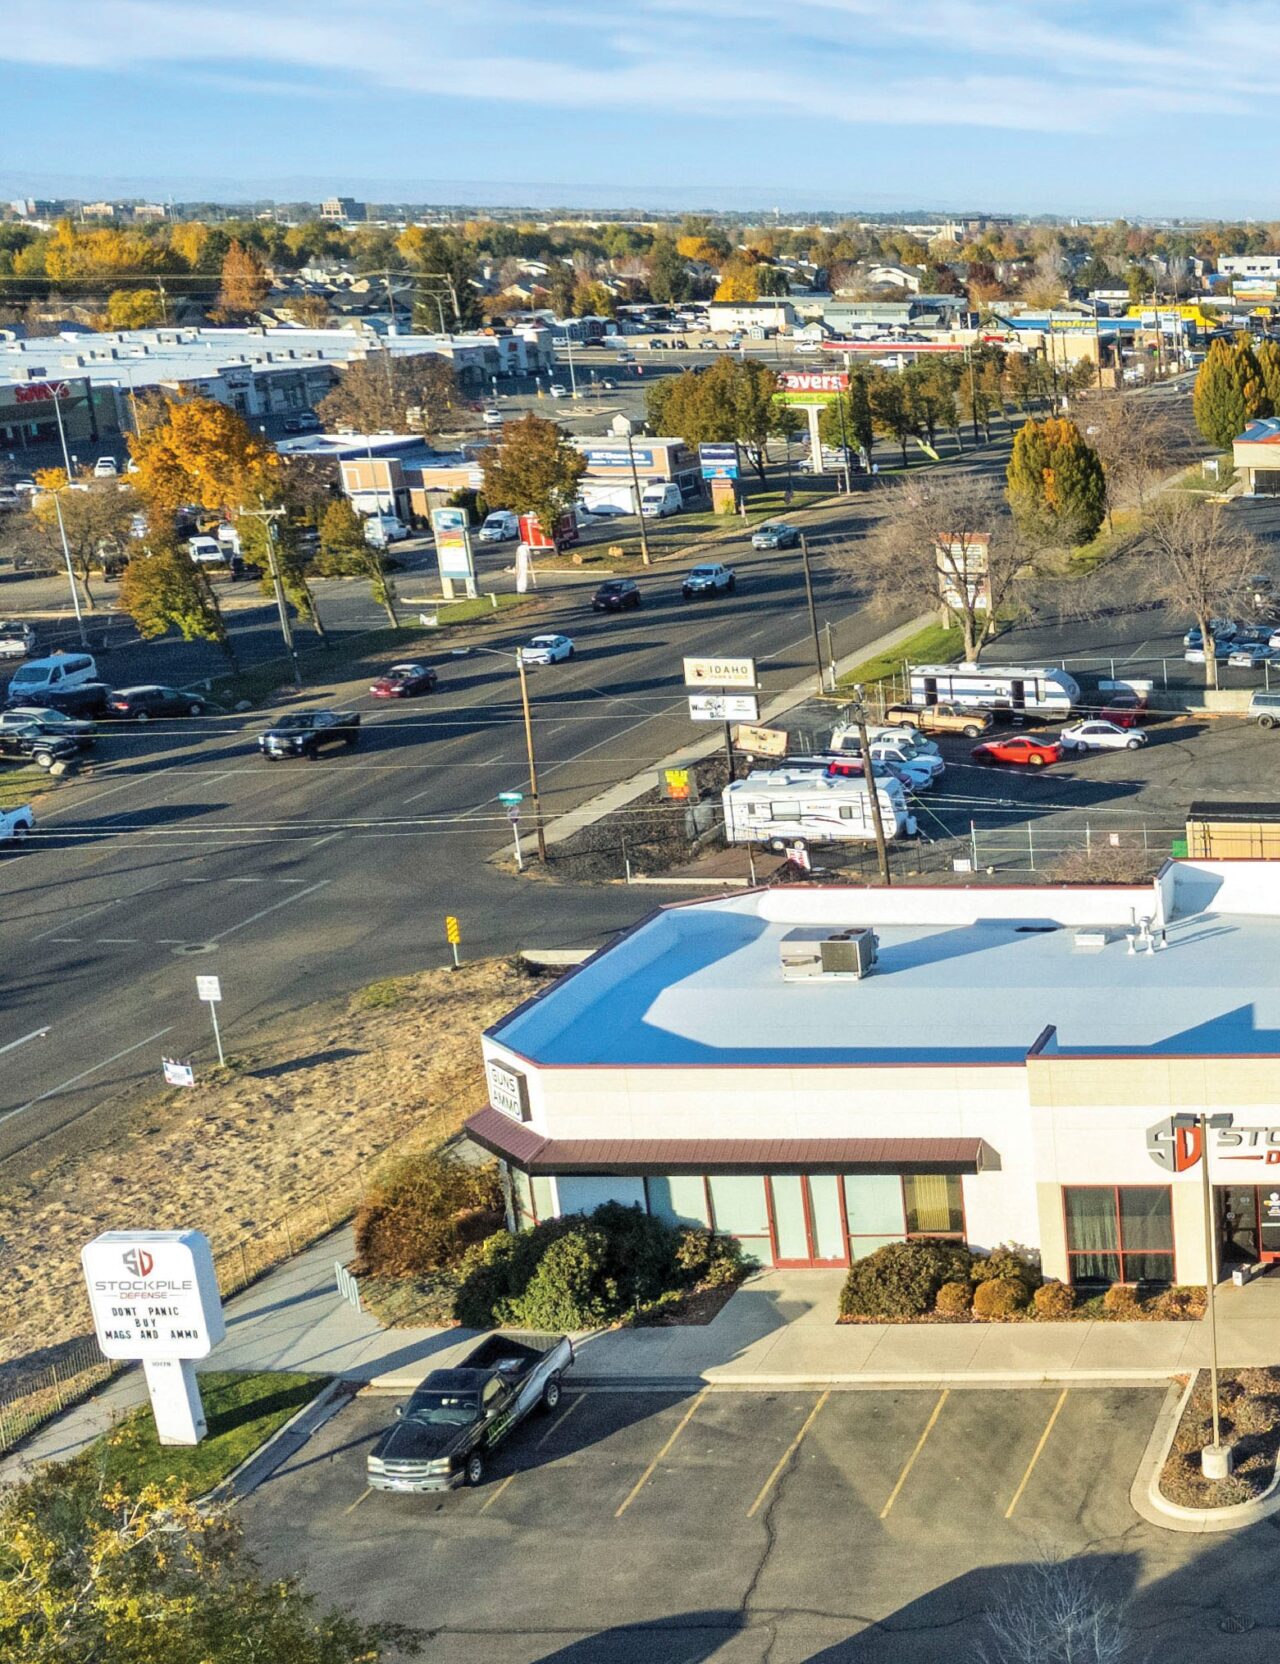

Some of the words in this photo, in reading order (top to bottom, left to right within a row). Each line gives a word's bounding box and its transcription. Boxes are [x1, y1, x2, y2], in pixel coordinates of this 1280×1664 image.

[709, 665, 748, 674] IDAHO
[491, 1068, 515, 1092] GUNS
[493, 1089, 520, 1116] AMMO
[1146, 1115, 1203, 1172] SD
[121, 1247, 154, 1278] SD
[95, 1280, 193, 1291] STOCKPILE
[119, 1291, 169, 1299] DEFENSE
[148, 1306, 179, 1316] PANIC
[134, 1318, 156, 1328] BUY
[105, 1329, 132, 1339] MAGS
[140, 1329, 159, 1339] AND
[170, 1329, 199, 1339] AMMO
